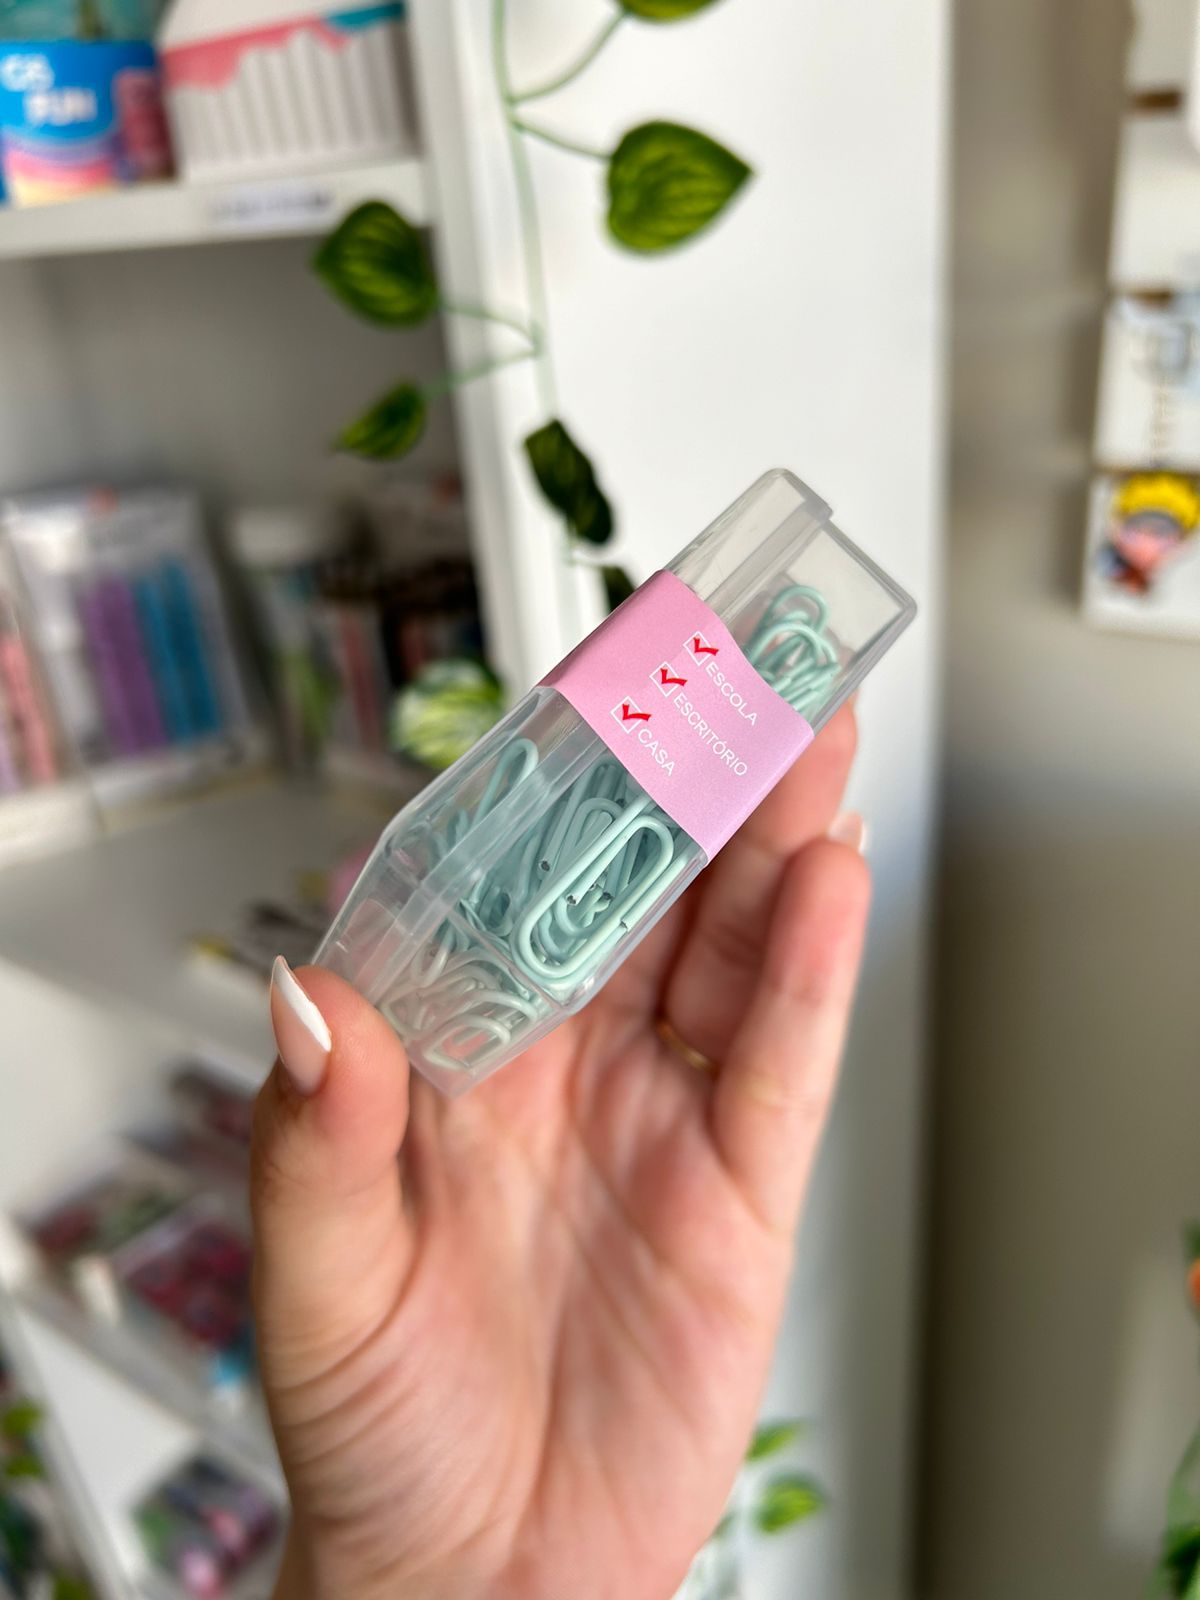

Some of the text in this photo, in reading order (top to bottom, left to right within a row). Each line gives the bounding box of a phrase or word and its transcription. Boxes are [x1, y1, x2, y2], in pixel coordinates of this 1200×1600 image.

[705, 661, 757, 726] ESCOLA
[637, 728, 676, 776] CASA
[673, 692, 748, 776] ESCRITÓRIO
